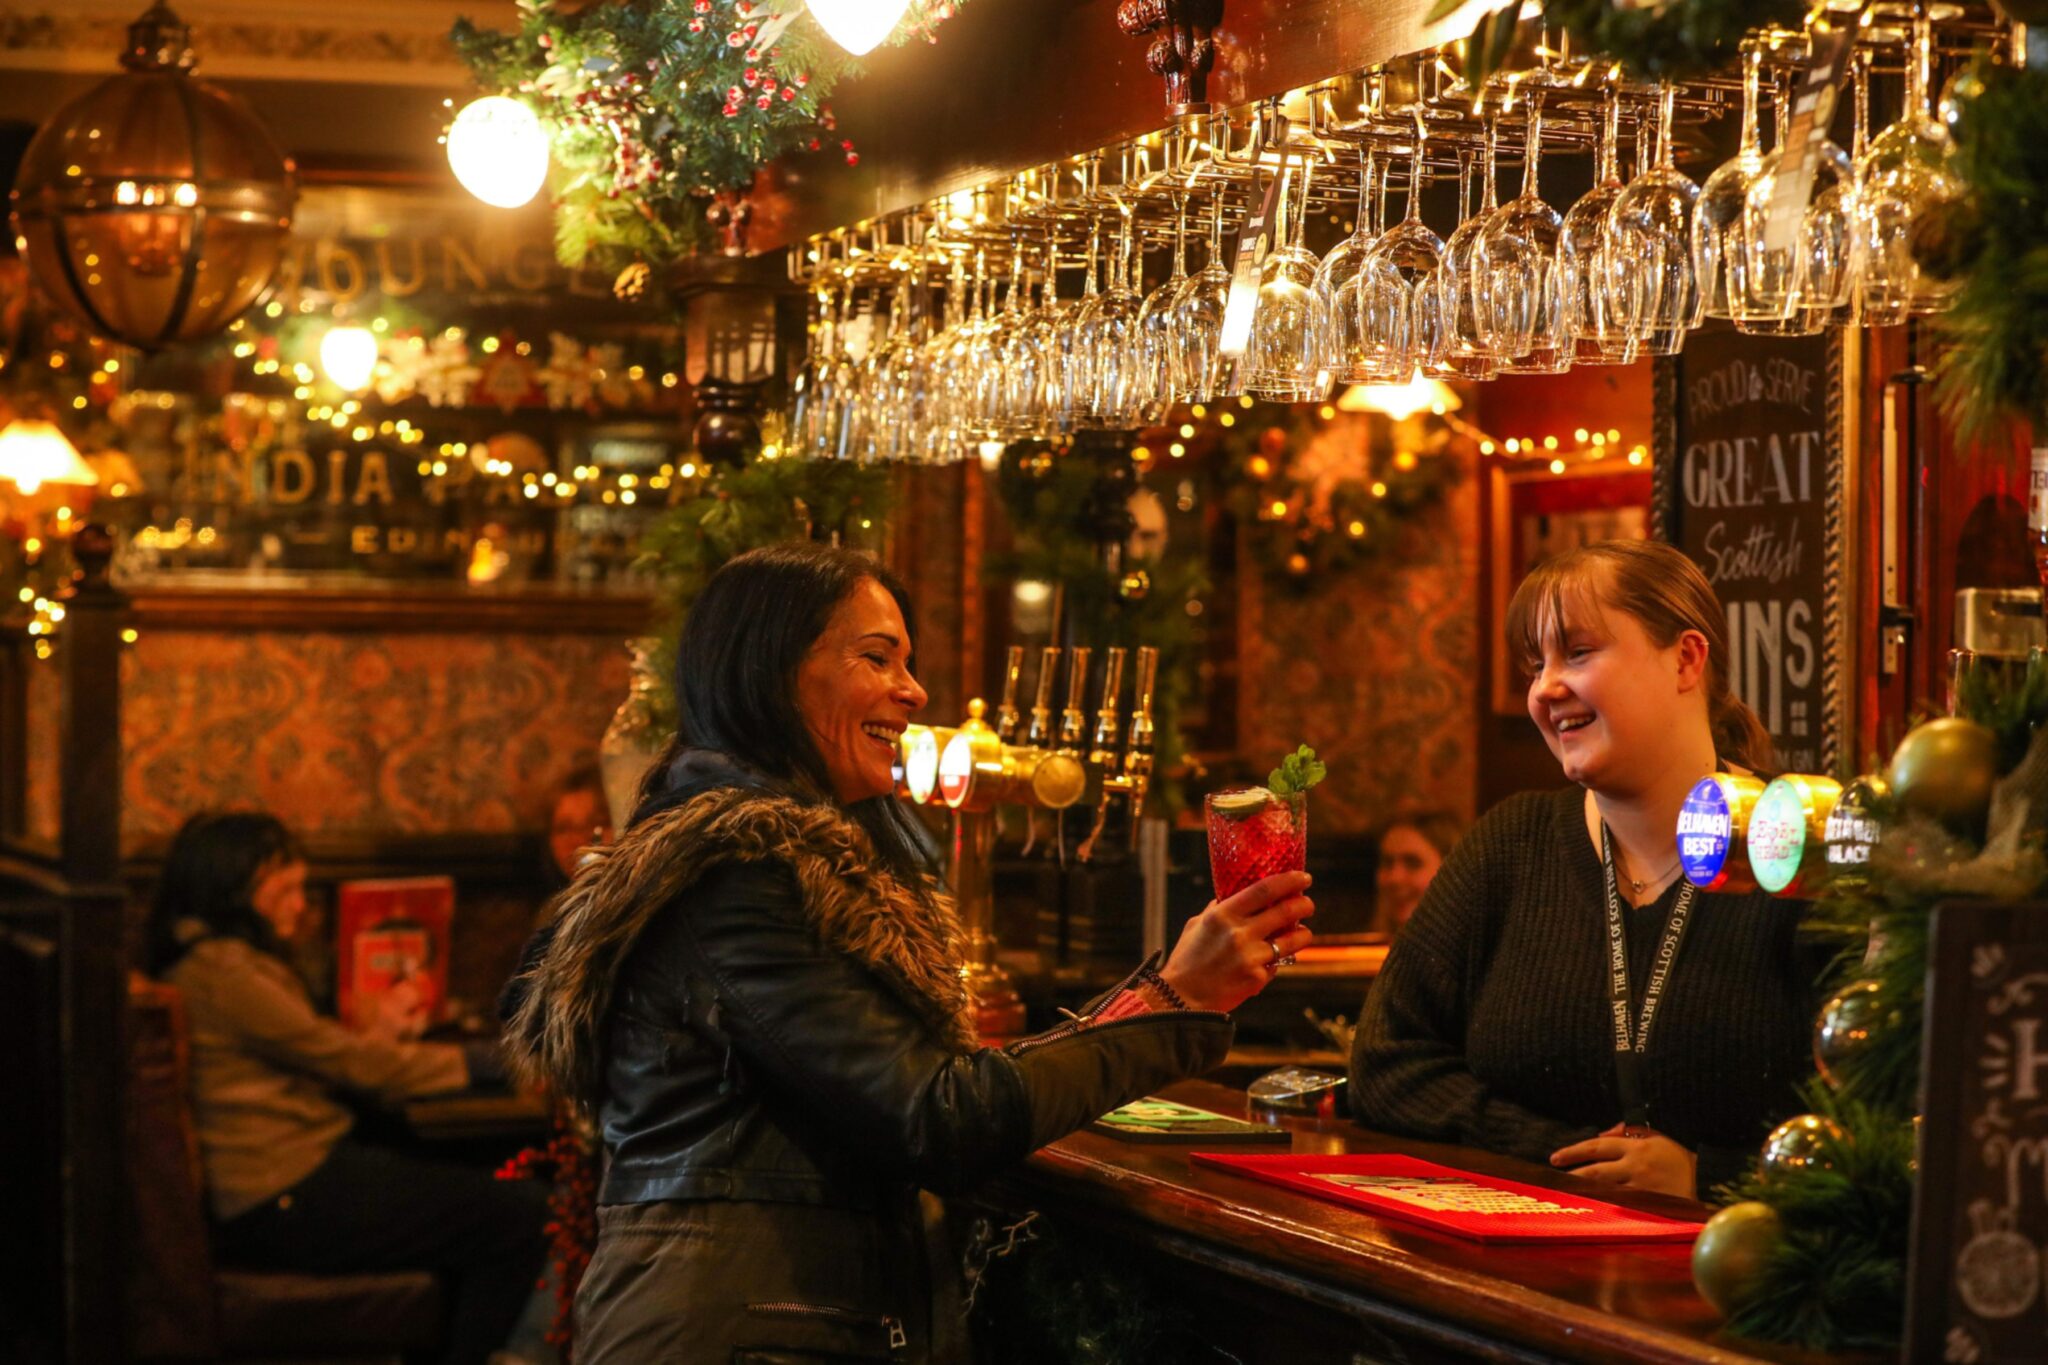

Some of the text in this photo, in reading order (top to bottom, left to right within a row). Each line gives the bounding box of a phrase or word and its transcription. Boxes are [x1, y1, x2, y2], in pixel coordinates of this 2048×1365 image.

[1682, 430, 1820, 508] GREAT
[1704, 516, 1804, 586] Scottish
[1727, 598, 1814, 735] INS
[1683, 836, 1717, 856] BEST
[1828, 844, 1871, 864] BLACK
[1605, 864, 1620, 921] SCOTTISH
[1610, 920, 1621, 937] OF
[1612, 940, 1625, 974] HOME
[1635, 881, 1696, 1053] HOME OF SCOTTISH BREWING
[1614, 973, 1626, 995] THE
[1613, 1000, 1631, 1051] BELHAVEN
